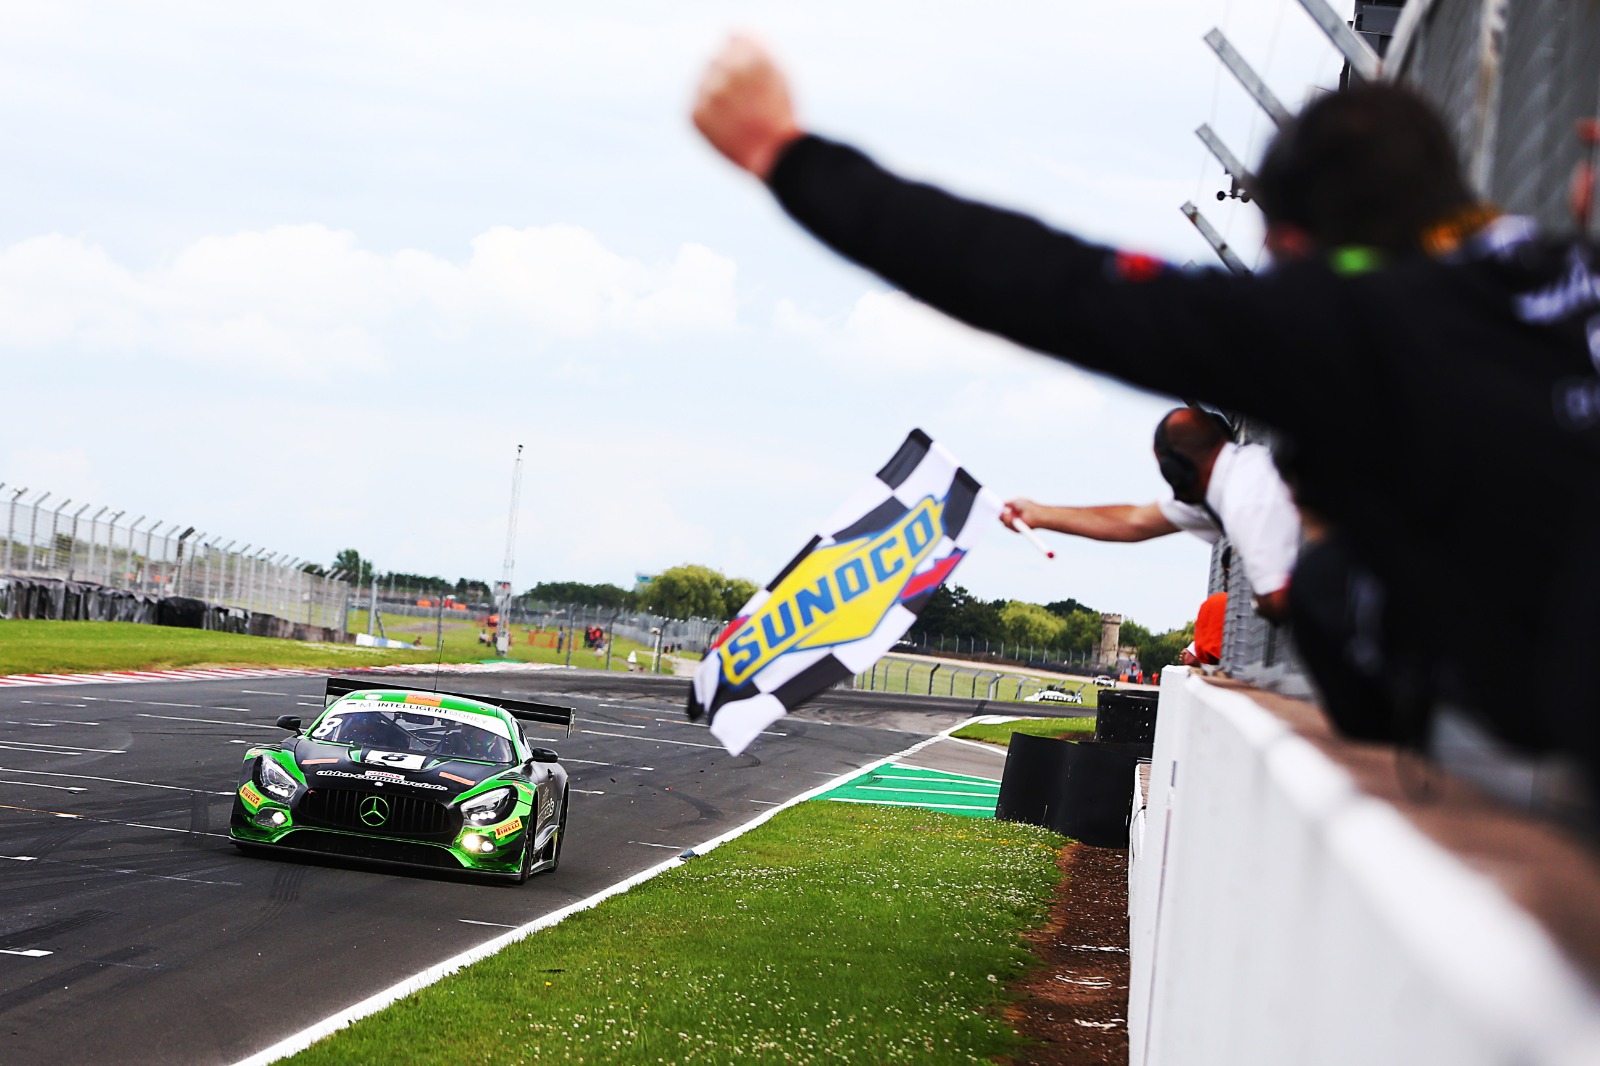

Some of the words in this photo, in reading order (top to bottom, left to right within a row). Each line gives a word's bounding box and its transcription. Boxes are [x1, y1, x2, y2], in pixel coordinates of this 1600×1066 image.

[728, 507, 935, 677] SUNOCO
[377, 702, 448, 714] INTELLIGENT
[449, 710, 488, 725] MONEY
[312, 717, 343, 737] 8
[241, 786, 260, 805] PIRELLI
[496, 819, 520, 836] PIRELLI
